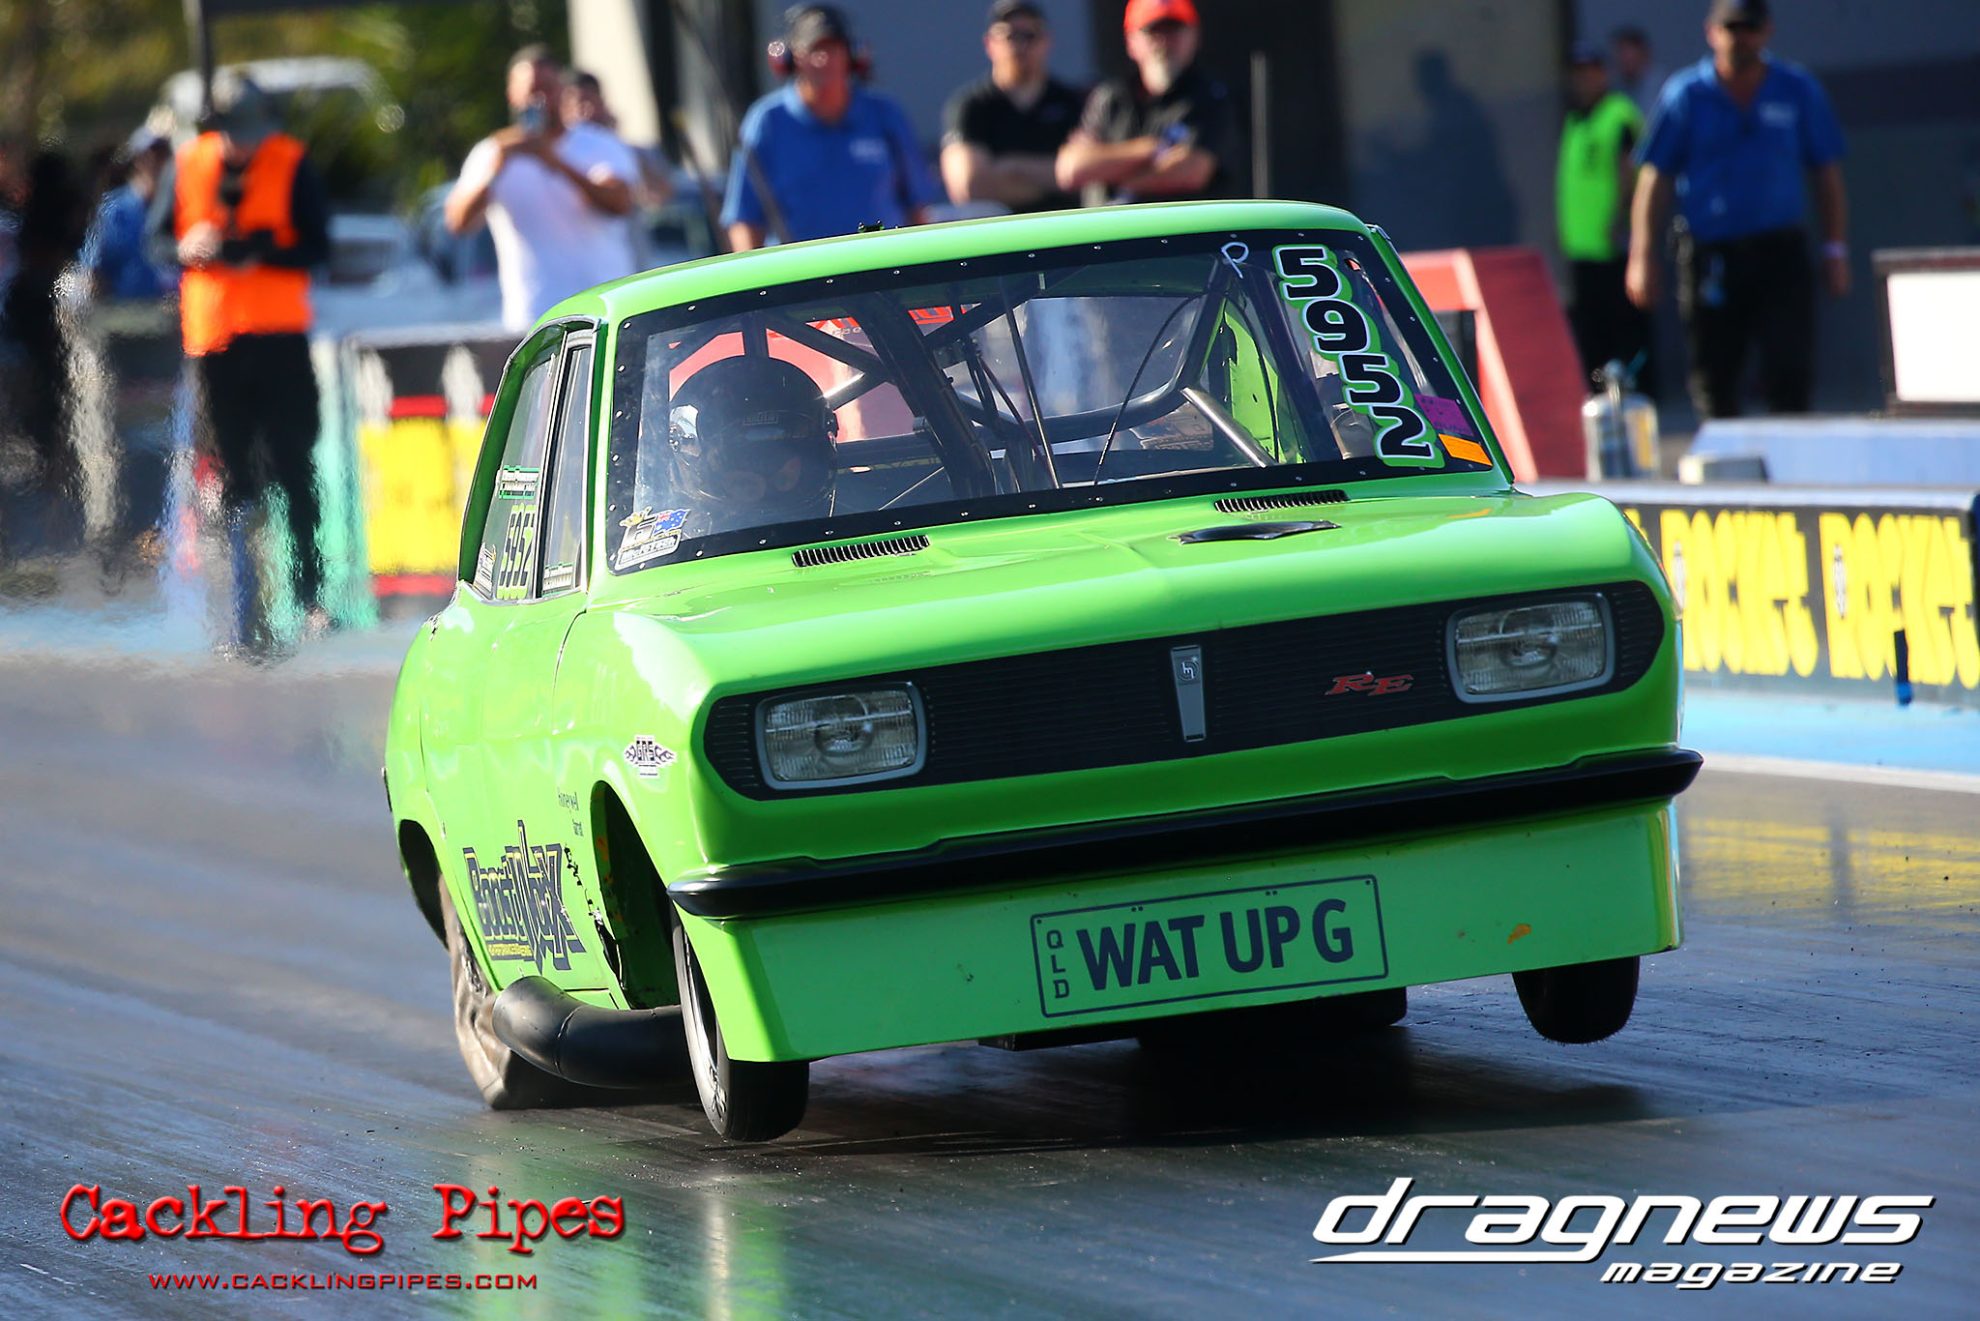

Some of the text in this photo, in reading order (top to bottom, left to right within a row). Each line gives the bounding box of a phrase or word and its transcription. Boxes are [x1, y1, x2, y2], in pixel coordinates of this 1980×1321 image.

[1275, 246, 1435, 459] 5952
[498, 508, 536, 591] 5952
[1324, 673, 1414, 697] RE
[1046, 929, 1071, 999] QLD
[1076, 898, 1355, 991] WAT UP G
